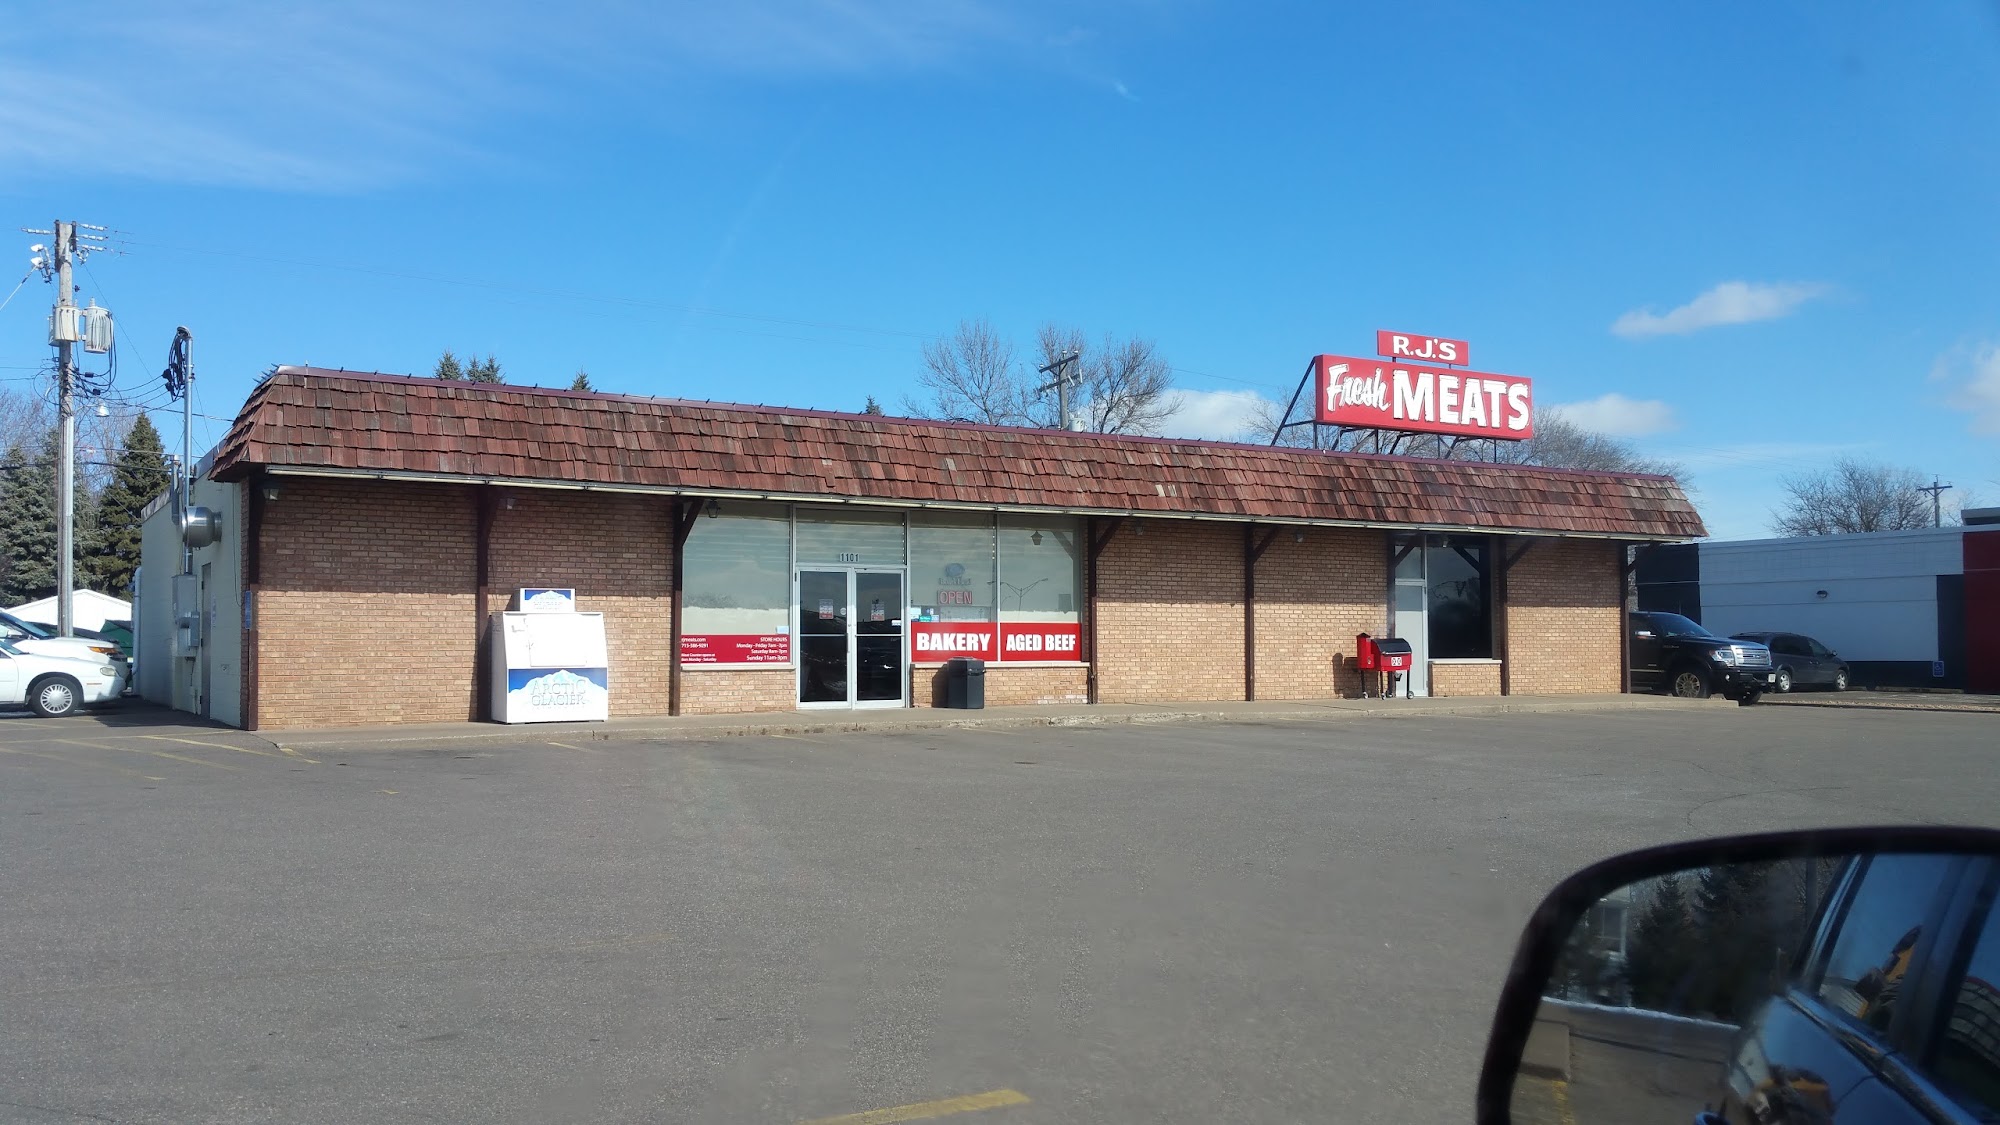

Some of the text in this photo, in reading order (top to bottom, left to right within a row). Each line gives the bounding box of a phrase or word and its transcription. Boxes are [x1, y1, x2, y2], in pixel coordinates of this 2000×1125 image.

[1392, 335, 1457, 361] R.J.'S
[1326, 363, 1529, 431] Fresh MEATS
[840, 553, 859, 562] 1101
[940, 590, 973, 604] OPEN
[916, 633, 991, 651] BAKERY
[1006, 634, 1076, 651] AGED BEEF
[530, 679, 586, 695] ARCTIC
[532, 694, 586, 706] GLACIER
